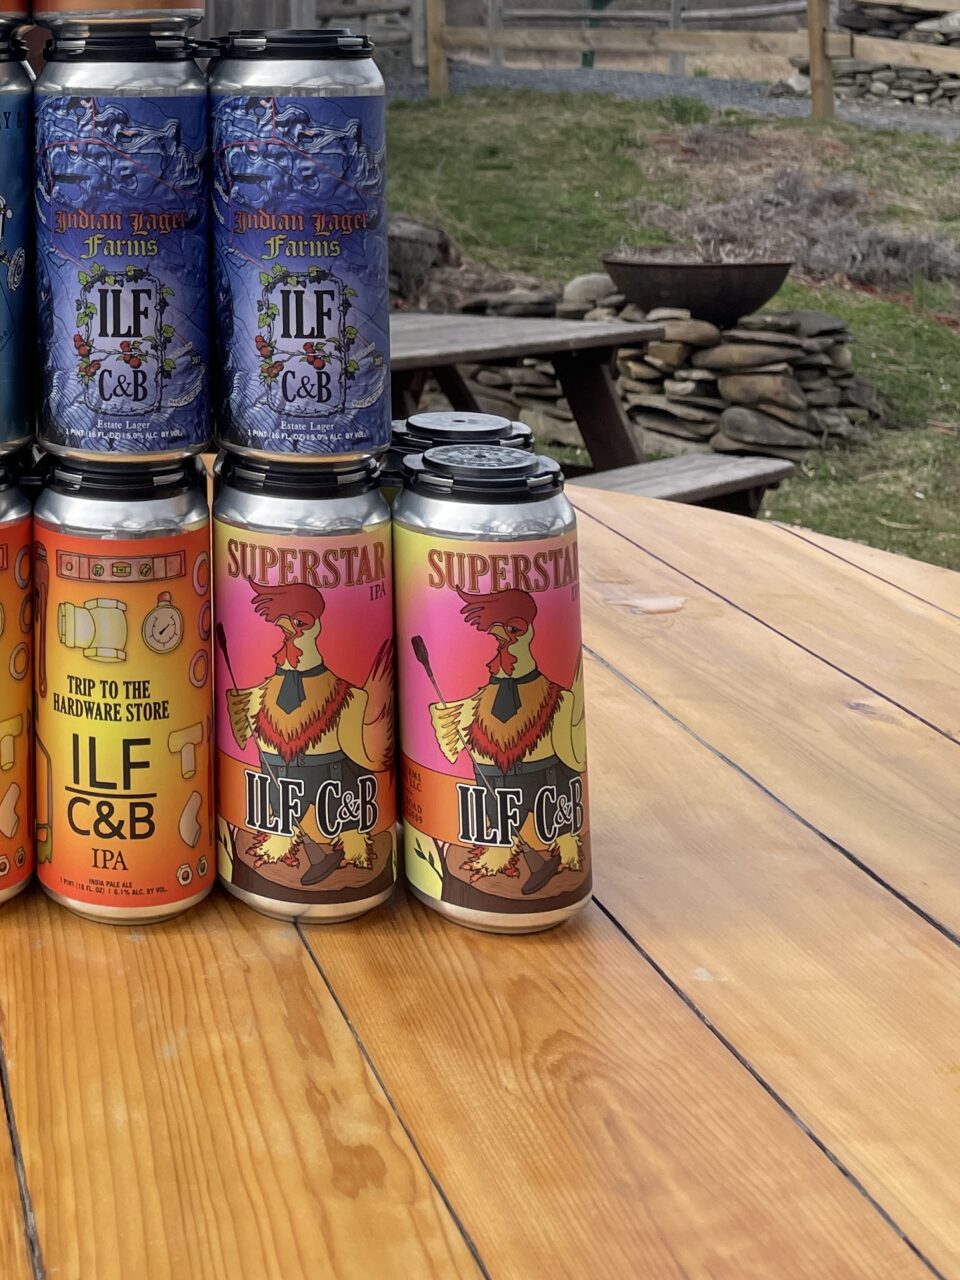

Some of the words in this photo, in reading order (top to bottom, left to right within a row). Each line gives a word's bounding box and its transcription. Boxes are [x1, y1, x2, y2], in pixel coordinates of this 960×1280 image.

[55, 209, 122, 233] Indian
[234, 208, 304, 234] Indian
[80, 233, 158, 259] Farms
[261, 234, 341, 260] Farms
[98, 288, 152, 338] ILF
[280, 289, 335, 339] ILF
[99, 369, 148, 402] C&B
[282, 370, 332, 403] C&B
[96, 420, 122, 429] Estate
[126, 420, 150, 431] Lager
[280, 421, 307, 430] Estate
[310, 422, 335, 432] Lager
[227, 538, 386, 589] SUPERSTAR
[369, 581, 386, 602] IPA
[67, 674, 95, 697] TRIP
[100, 680, 118, 699] TO
[123, 680, 151, 699] THE
[53, 692, 122, 722] HARDWARE
[126, 700, 170, 722] STORE
[71, 732, 152, 791] ILF
[244, 769, 305, 837] ILF
[315, 774, 379, 838] C&B
[456, 784, 523, 848] ILF
[534, 776, 584, 845] C&B
[65, 796, 157, 840] C&B
[91, 847, 129, 871] IPA
[89, 879, 104, 887] INDIA
[122, 881, 132, 889] ALE
